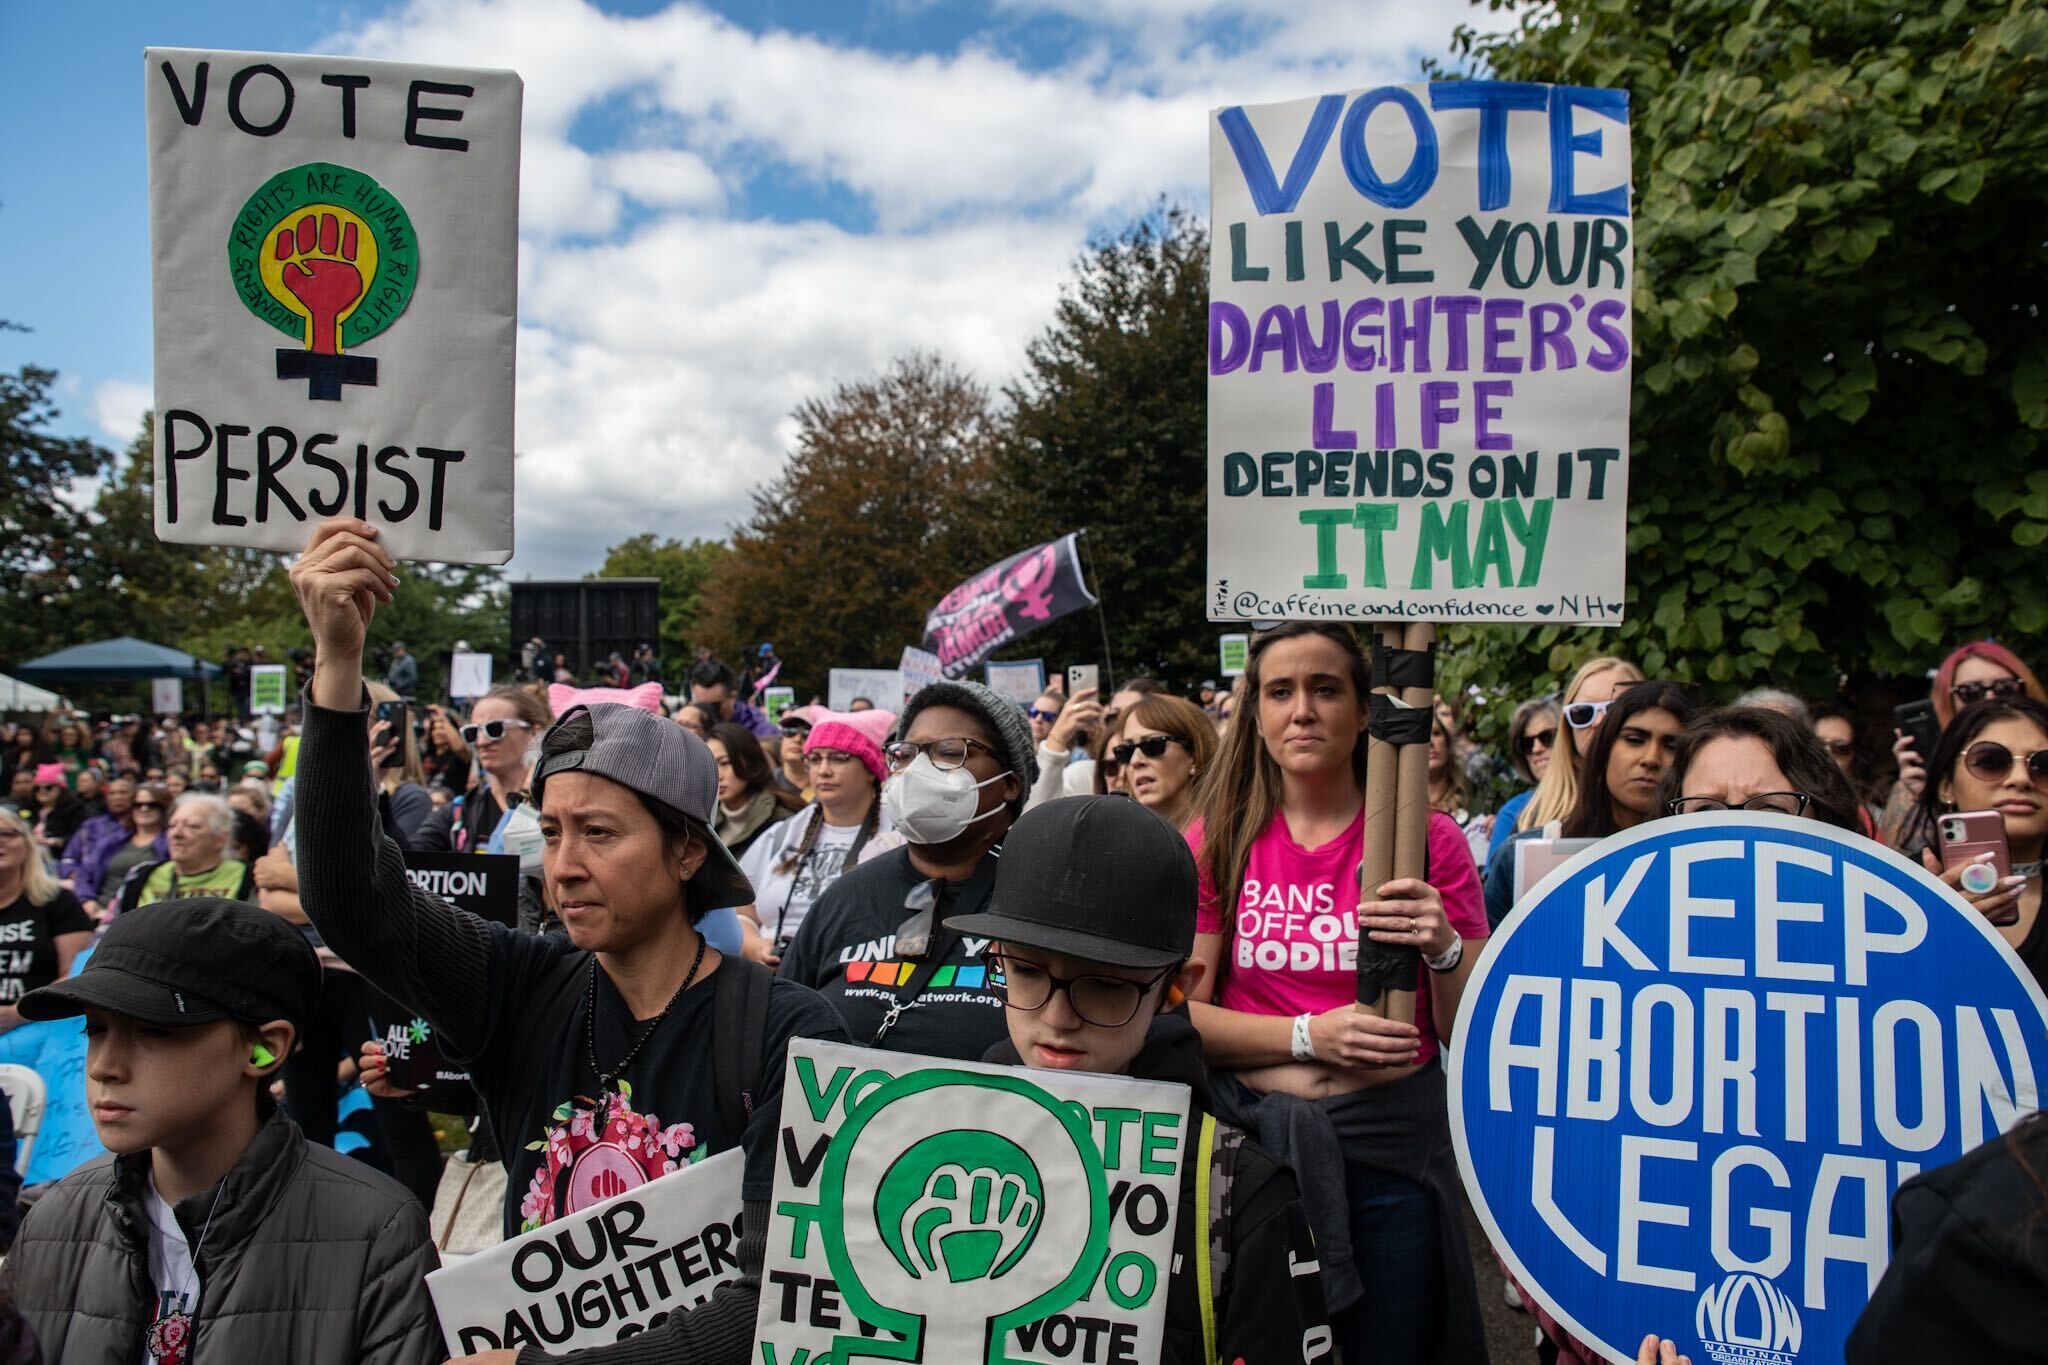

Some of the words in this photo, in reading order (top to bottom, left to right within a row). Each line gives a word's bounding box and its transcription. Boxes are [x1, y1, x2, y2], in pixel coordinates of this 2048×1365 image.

[161, 61, 475, 152] VOTE
[306, 171, 347, 195] ARE
[1217, 79, 1630, 217] VOTE
[236, 181, 295, 250] RIGHTS
[354, 184, 409, 251] HUMAN
[1229, 219, 1435, 284] LIKE
[1456, 215, 1629, 290] YOUR
[354, 259, 409, 335] RIGHTS
[1209, 293, 1630, 375] DAUGHTER'S
[1312, 380, 1514, 451] LIFE
[163, 410, 466, 531] PERSIST
[1223, 449, 1456, 498] DEPENDS
[1468, 450, 1538, 497] ON
[1556, 447, 1621, 500] IT
[1299, 501, 1399, 590] IT
[1409, 496, 1555, 590] MAY
[1237, 908, 1304, 941] OFF
[1308, 911, 1360, 943] OU
[1244, 879, 1335, 914] BANS
[1582, 839, 1929, 987] KEEP
[1237, 938, 1358, 972] BODIE
[387, 1024, 411, 1043] ALL
[1488, 974, 2042, 1157] ABORTION
[511, 1199, 659, 1294] OUR
[1531, 1126, 1921, 1310] LEGA
[457, 1211, 744, 1357] DAUGHTER
[1695, 1274, 1803, 1354] NOW
[1013, 1313, 1139, 1365] VOTE
[1704, 1342, 1793, 1363] NATIONAL
